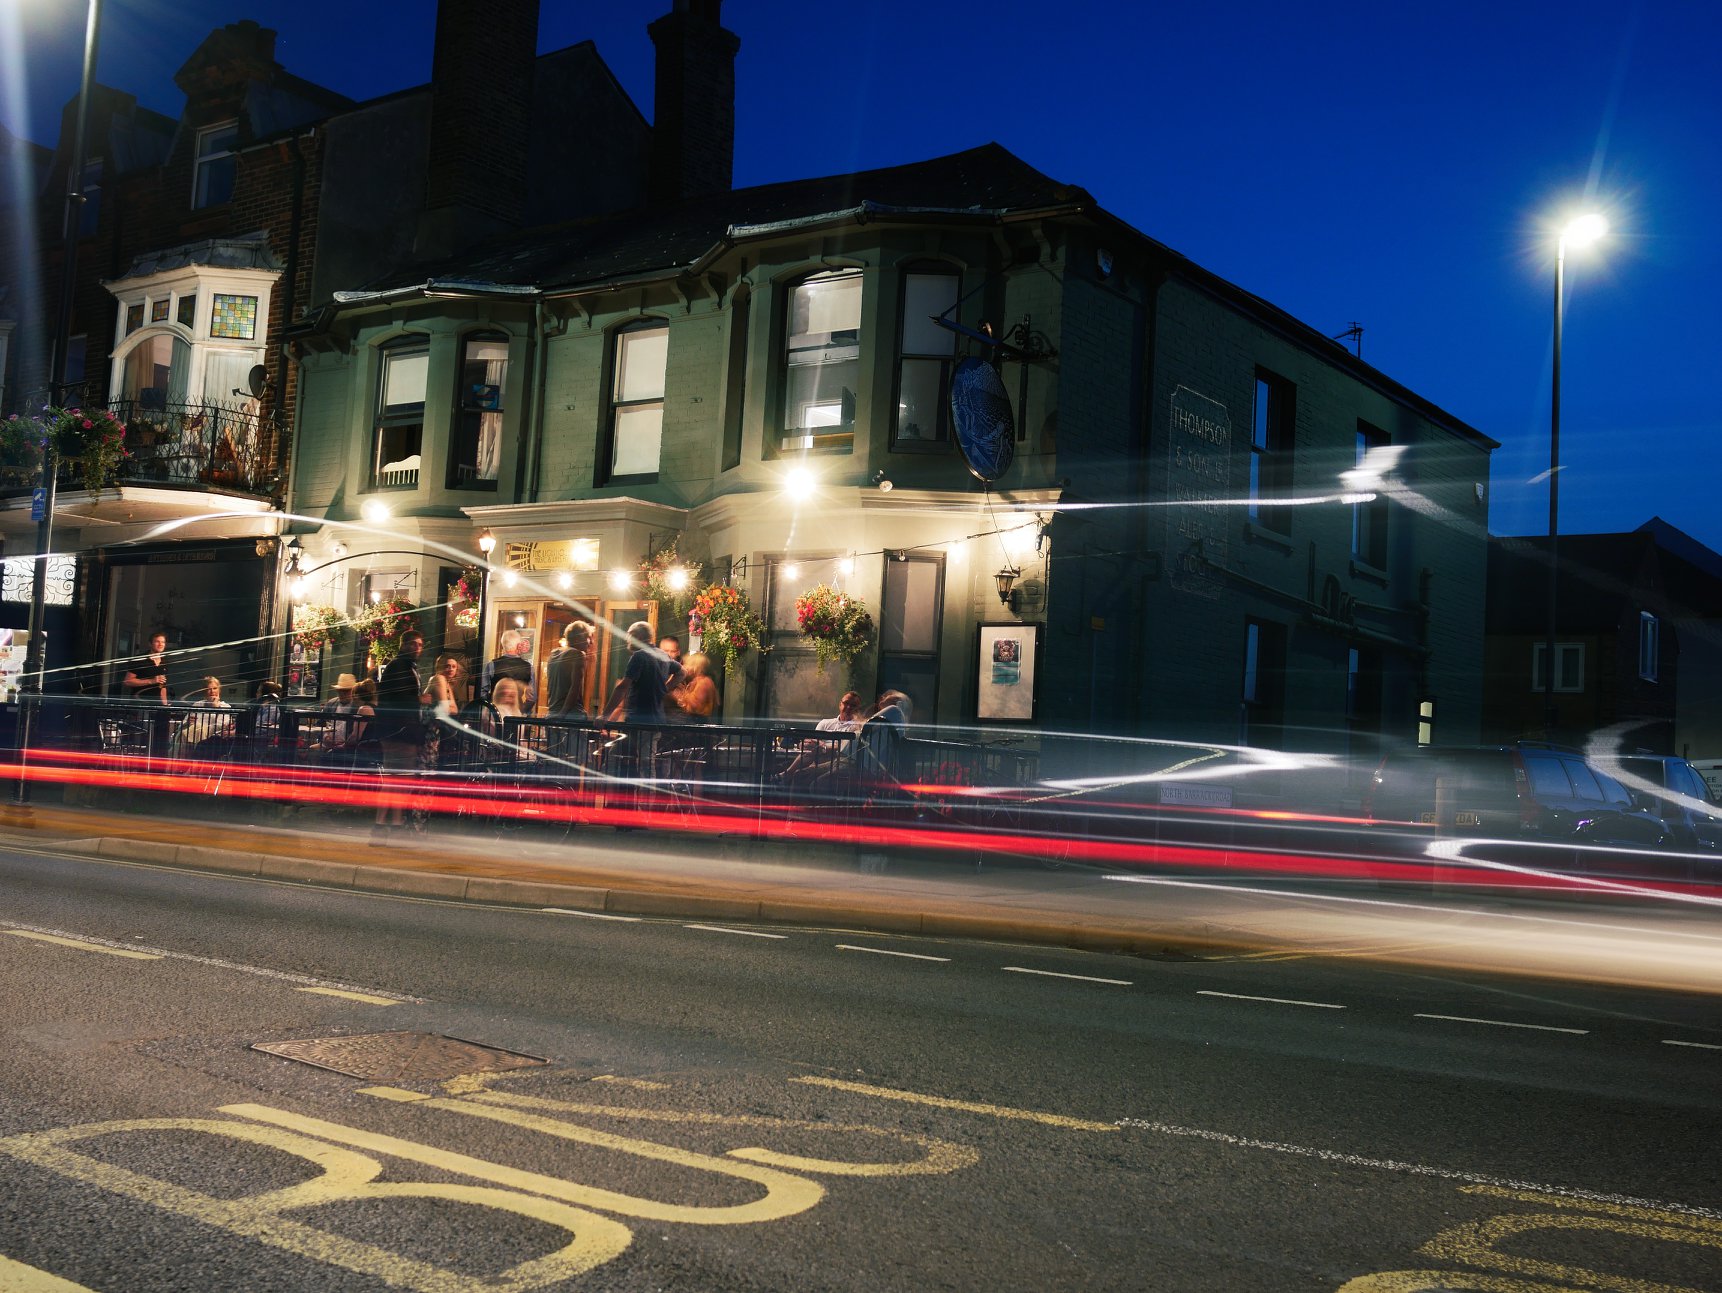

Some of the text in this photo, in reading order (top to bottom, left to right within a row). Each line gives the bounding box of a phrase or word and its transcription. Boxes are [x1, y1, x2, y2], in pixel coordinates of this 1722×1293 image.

[1173, 405, 1228, 447] THOMPSON
[1187, 450, 1210, 478] SON
[1161, 787, 1182, 799] NORTH
[1215, 790, 1232, 802] ROAD
[0, 1071, 980, 1293] BUS
